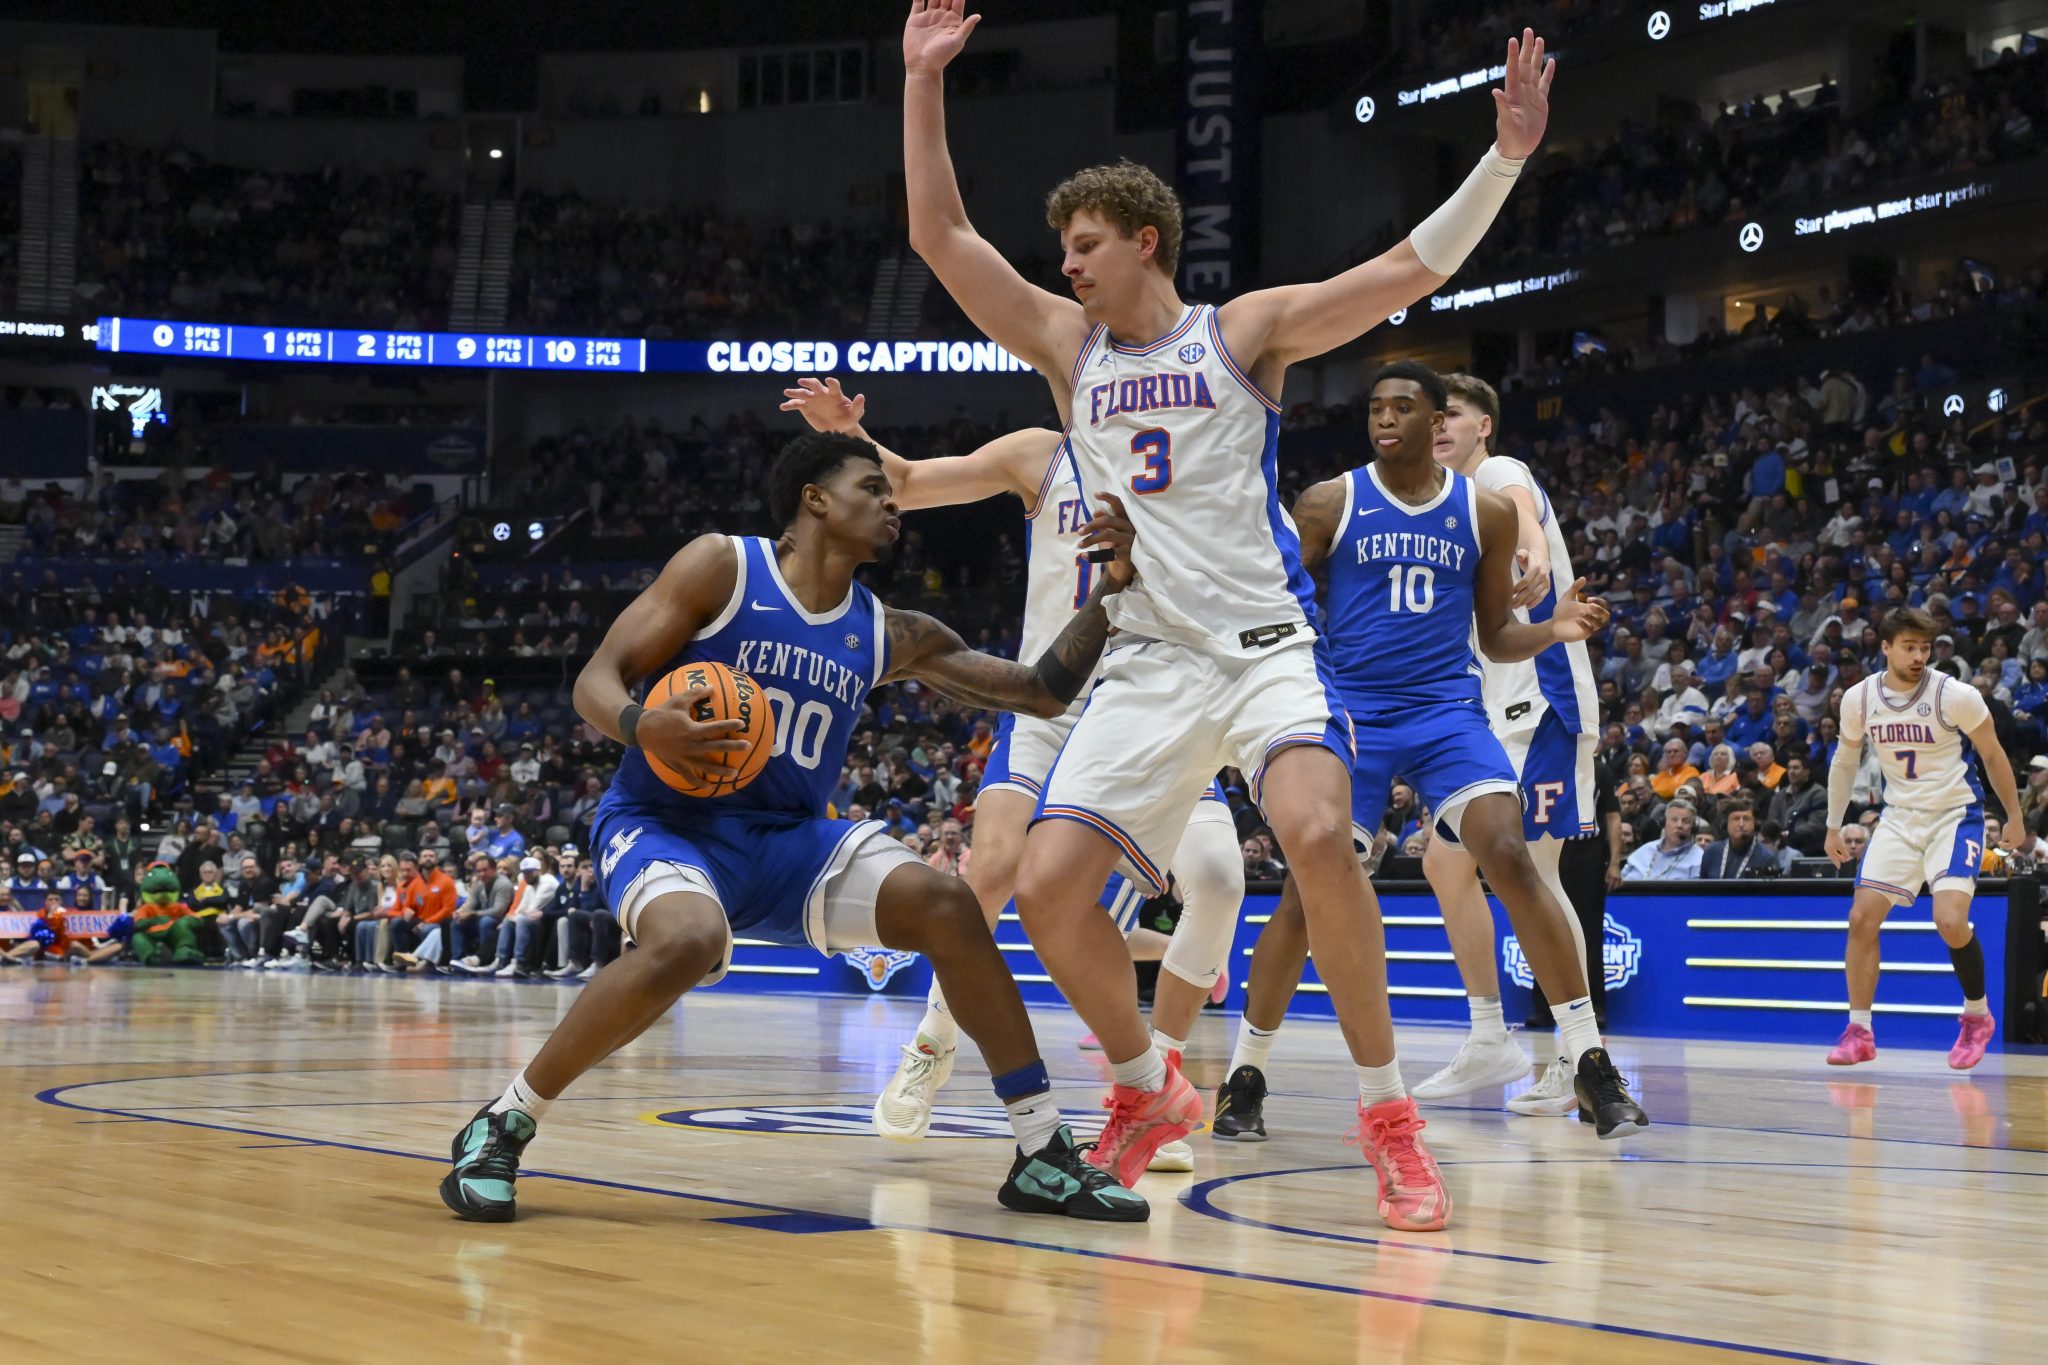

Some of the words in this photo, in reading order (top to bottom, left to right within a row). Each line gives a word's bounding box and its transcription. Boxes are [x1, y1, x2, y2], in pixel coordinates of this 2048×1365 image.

[1186, 36, 1233, 183] JUST
[1795, 217, 1823, 235] Star
[1914, 191, 1943, 211] star
[1185, 204, 1232, 298] ME
[1430, 295, 1453, 311] Star
[1523, 275, 1546, 292] star
[18, 322, 64, 337] POINTS
[153, 324, 174, 347] 0
[194, 326, 221, 339] PTS
[296, 332, 322, 344] PTS
[397, 335, 422, 347] PTS
[194, 339, 220, 352] FLS
[263, 331, 275, 353] 1
[296, 344, 321, 357] FLS
[357, 334, 376, 357] 2
[397, 348, 421, 359] FLS
[456, 337, 477, 359] 9
[497, 338, 522, 350] PTS
[545, 340, 576, 363] 10
[596, 342, 621, 353] PTS
[1180, 343, 1203, 362] SEC
[497, 350, 521, 362] FLS
[596, 354, 621, 366] FLS
[707, 341, 838, 372] CLOSED
[1090, 371, 1216, 426] FLORIDA
[1131, 426, 1172, 495] 3
[1356, 532, 1465, 571] KENTUCKY
[1388, 564, 1435, 614] 10
[735, 640, 865, 711] KENTUCKY
[686, 668, 715, 722] NCA
[764, 686, 833, 770] 00
[1869, 723, 1936, 744] FLORIDA
[1895, 750, 1918, 780] 7
[1534, 781, 1564, 824] F
[1965, 839, 1981, 868] F
